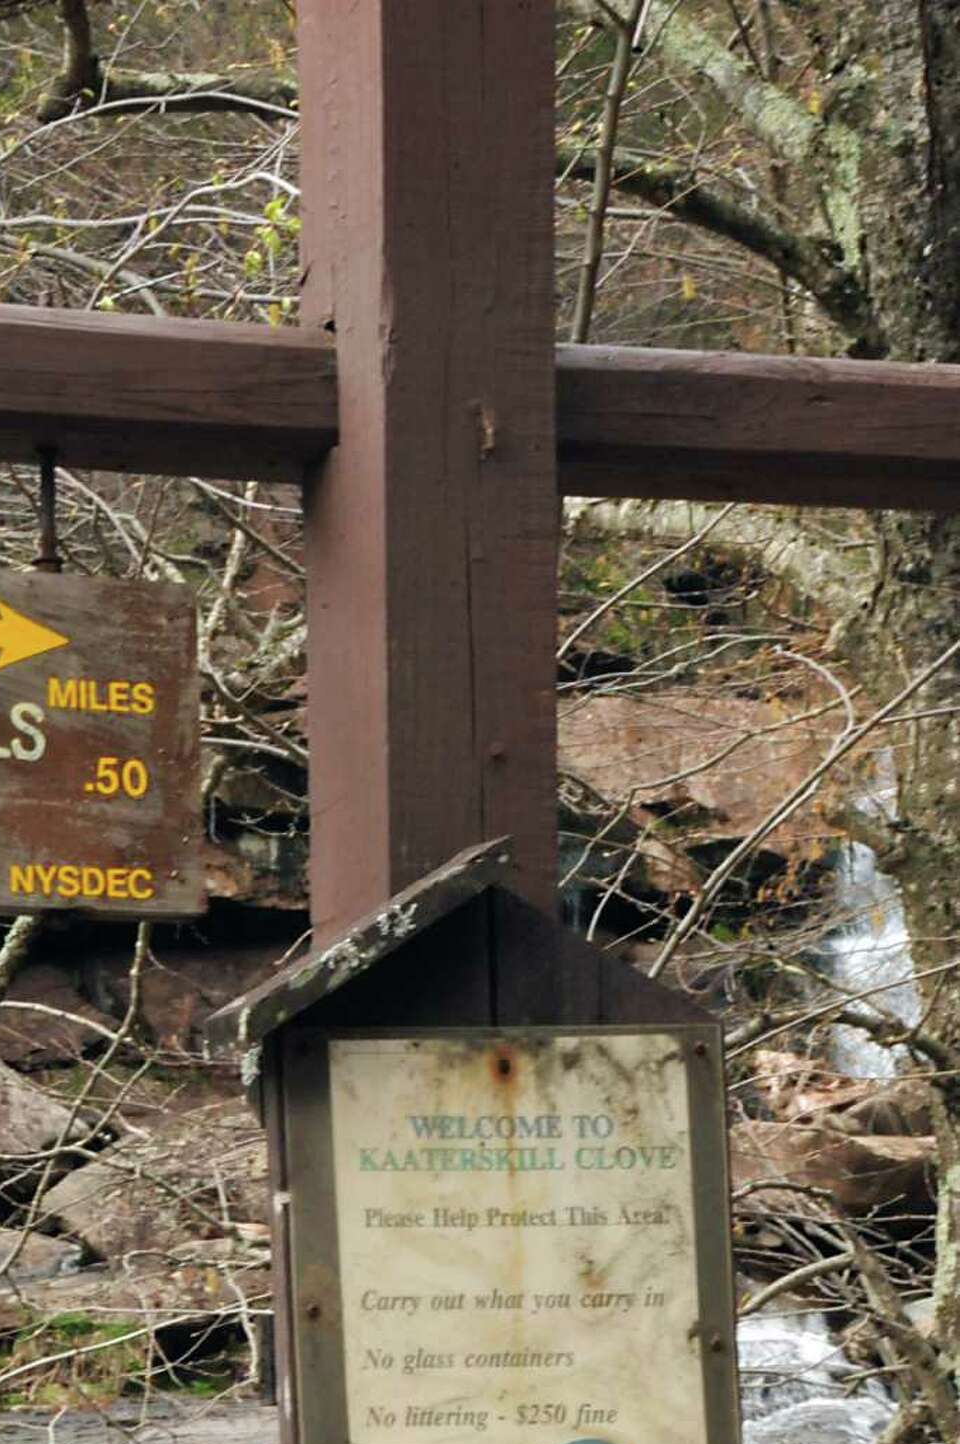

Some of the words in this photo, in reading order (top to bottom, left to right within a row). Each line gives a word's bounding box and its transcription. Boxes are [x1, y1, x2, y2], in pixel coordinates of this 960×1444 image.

[48, 677, 156, 715] MILES
[83, 757, 149, 798] .50
[9, 864, 156, 900] NYSDEC
[408, 1115, 564, 1140] WELCOME
[572, 1114, 615, 1137] TO
[358, 1146, 566, 1172] KAATERSKILL
[574, 1145, 679, 1170] CLOVE
[364, 1208, 424, 1229] Please
[432, 1207, 478, 1231] Help
[486, 1207, 556, 1228] Protect
[565, 1206, 607, 1227] This
[360, 1289, 420, 1315] Carry
[430, 1291, 463, 1310] out
[474, 1288, 524, 1309] what
[531, 1292, 571, 1314] you
[580, 1290, 635, 1312] carry
[644, 1286, 665, 1308] in
[362, 1348, 394, 1369] No
[403, 1347, 454, 1375] glass
[464, 1346, 575, 1368] containers
[365, 1406, 396, 1427] No
[404, 1405, 489, 1432] littering
[514, 1402, 567, 1426] $250
[572, 1402, 618, 1433] fine
